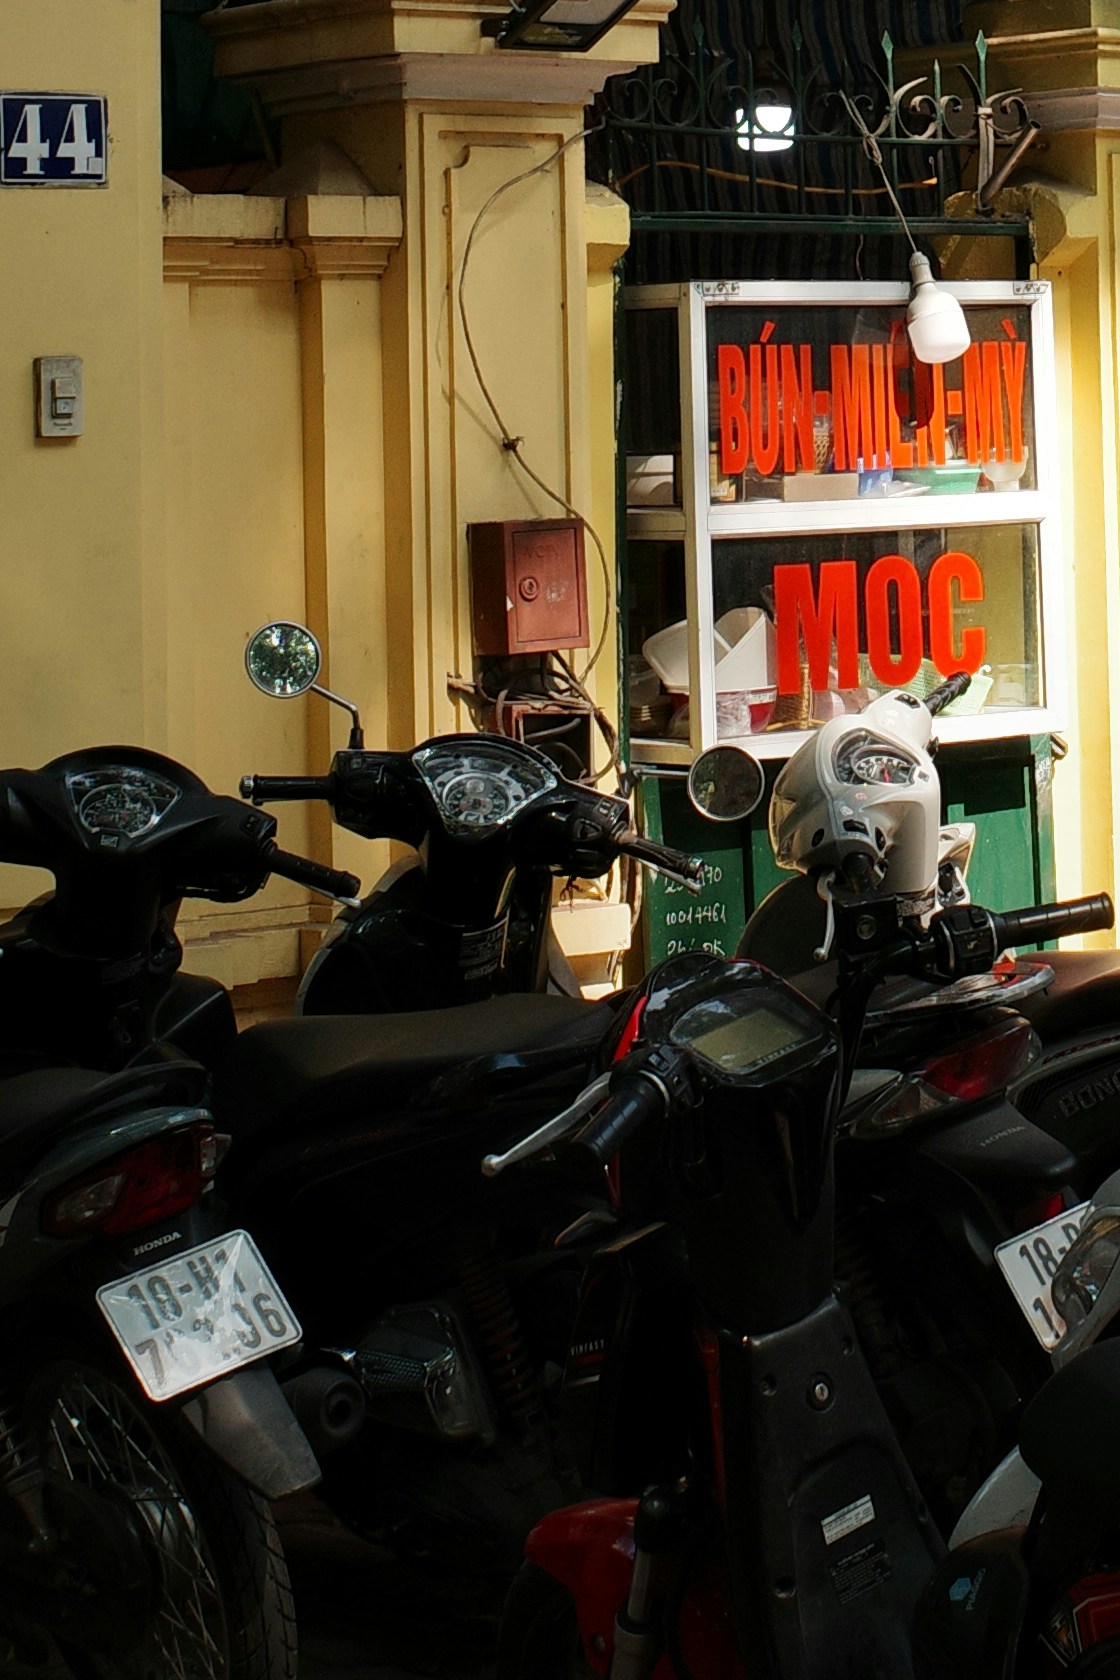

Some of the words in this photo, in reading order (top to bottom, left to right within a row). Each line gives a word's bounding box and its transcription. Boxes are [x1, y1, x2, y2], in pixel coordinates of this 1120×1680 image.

[7, 103, 97, 175] 44
[773, 551, 986, 696] MOC
[132, 1230, 184, 1257] HONDA
